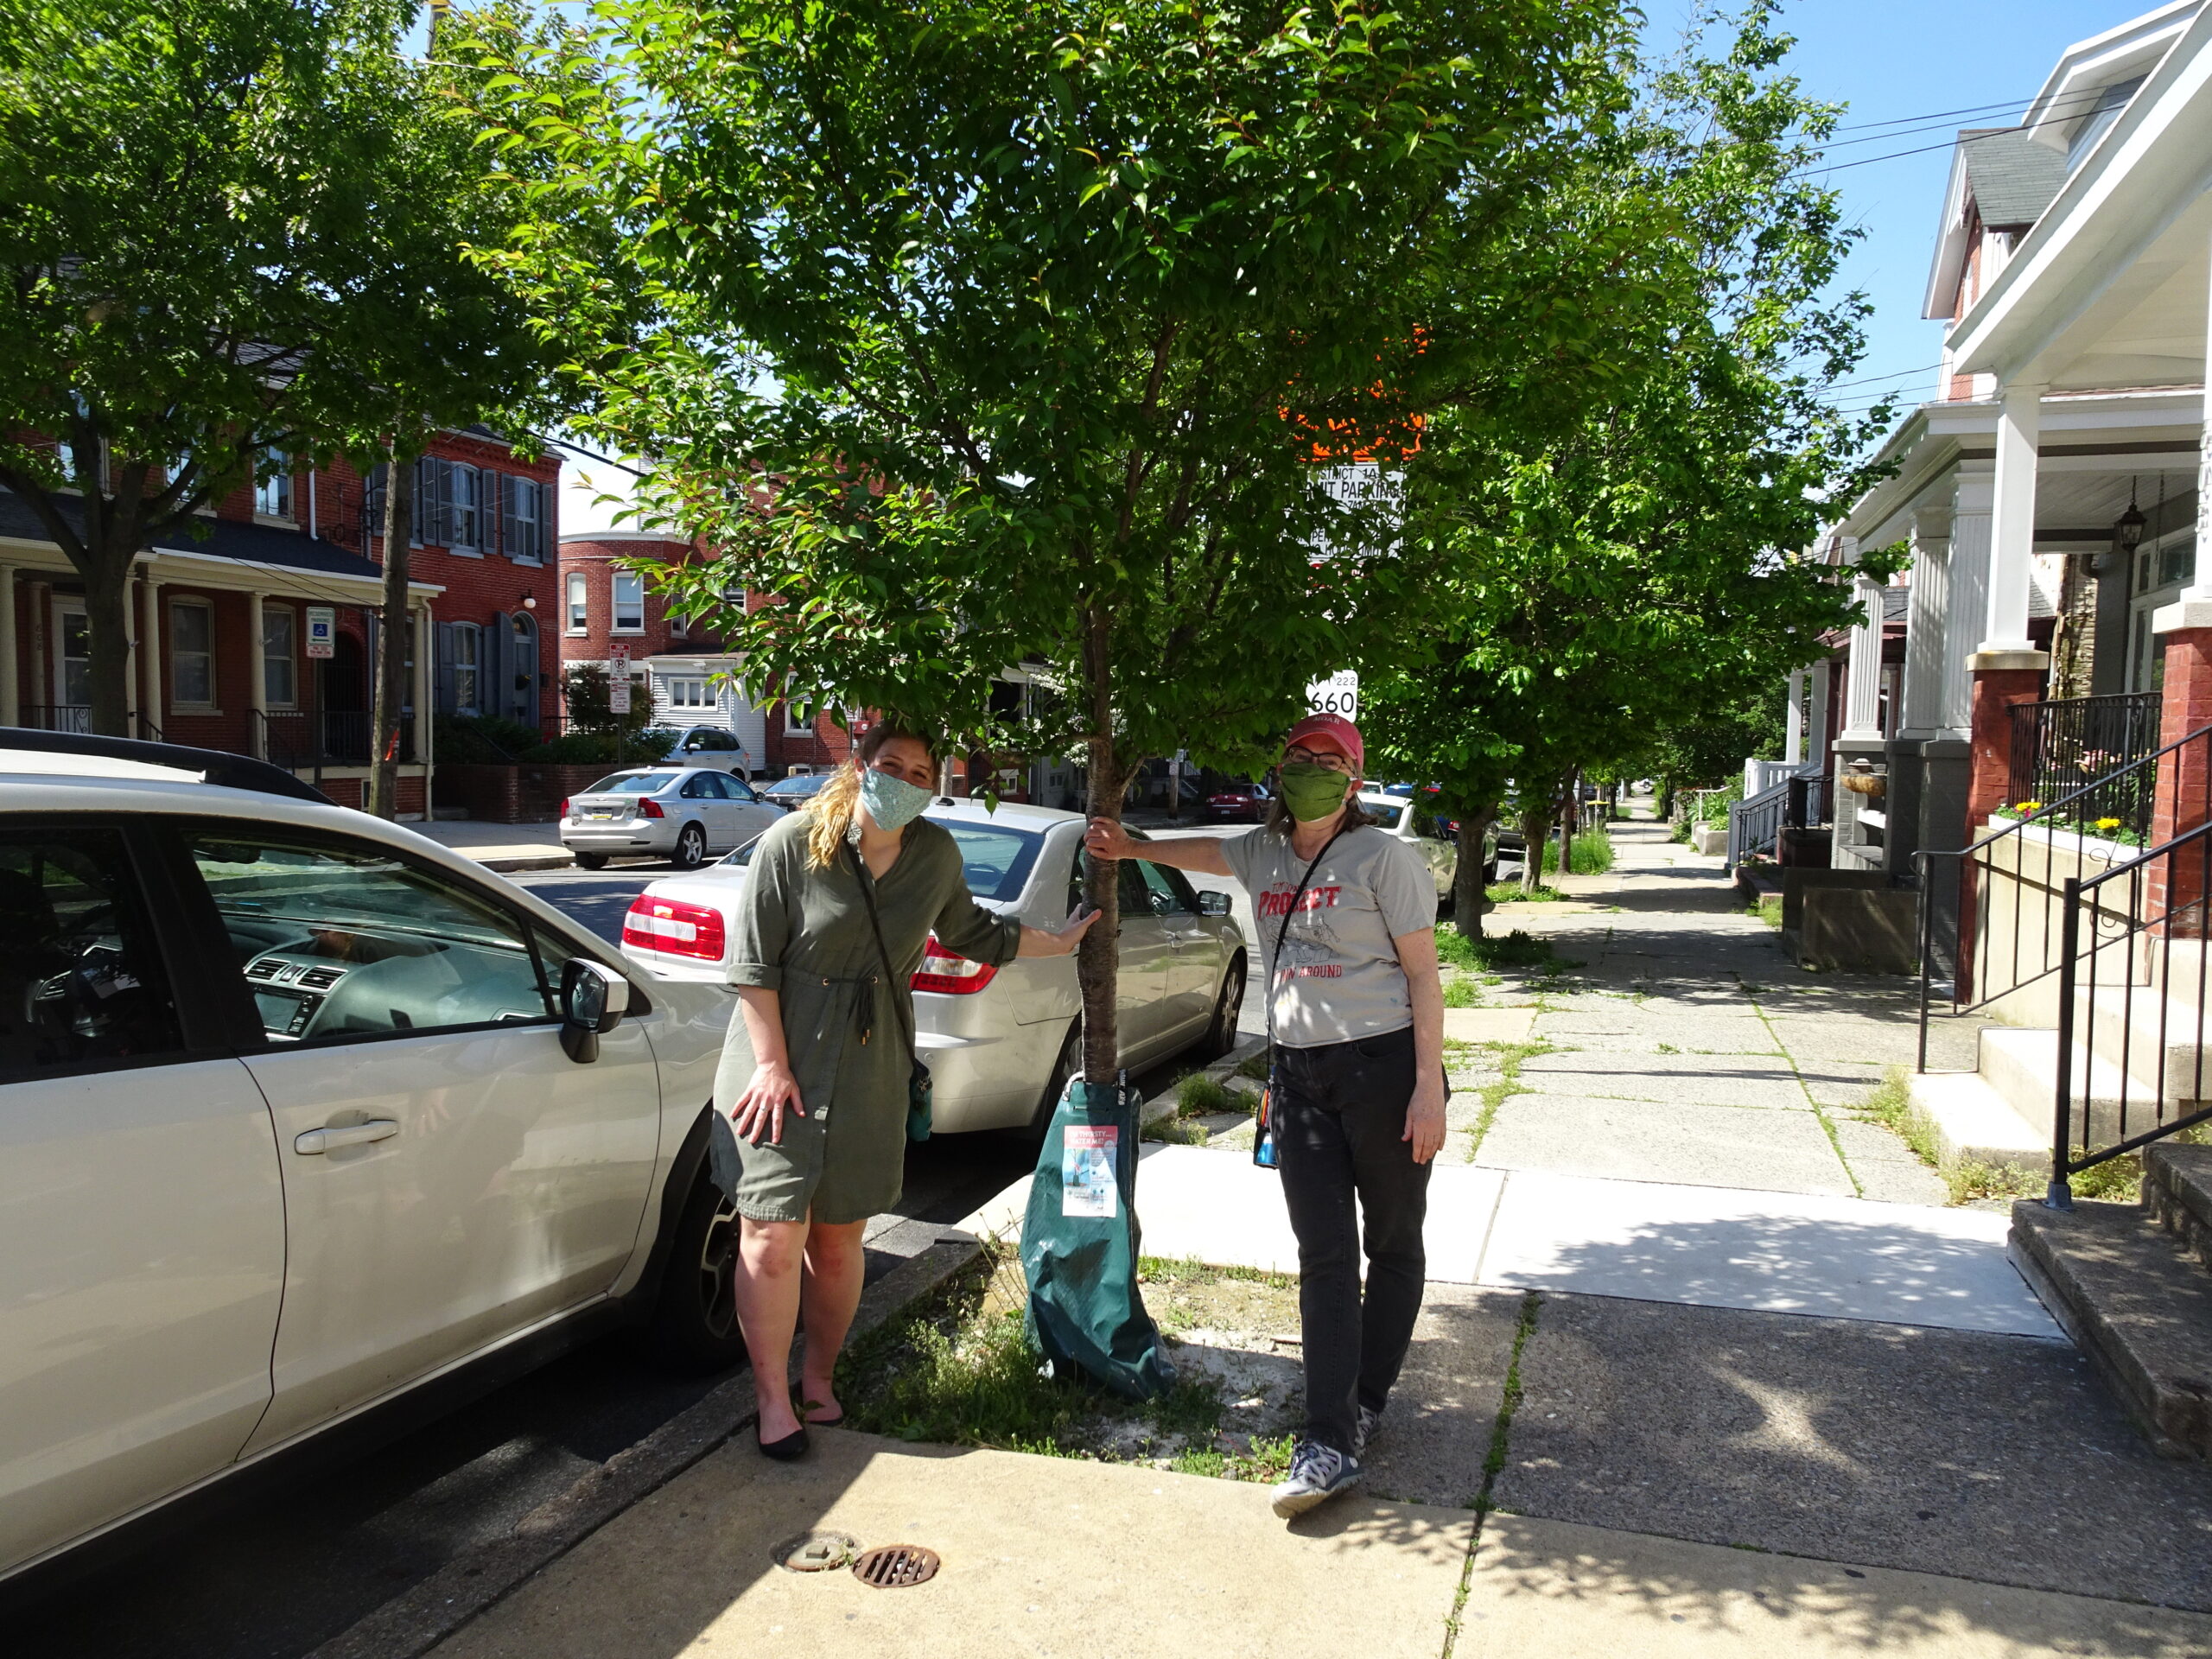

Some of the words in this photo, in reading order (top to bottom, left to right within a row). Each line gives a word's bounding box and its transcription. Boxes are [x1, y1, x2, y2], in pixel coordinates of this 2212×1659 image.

[1311, 691, 1354, 713] 660
[1257, 886, 1342, 921] PROECT
[1299, 964, 1342, 978] AROUND
